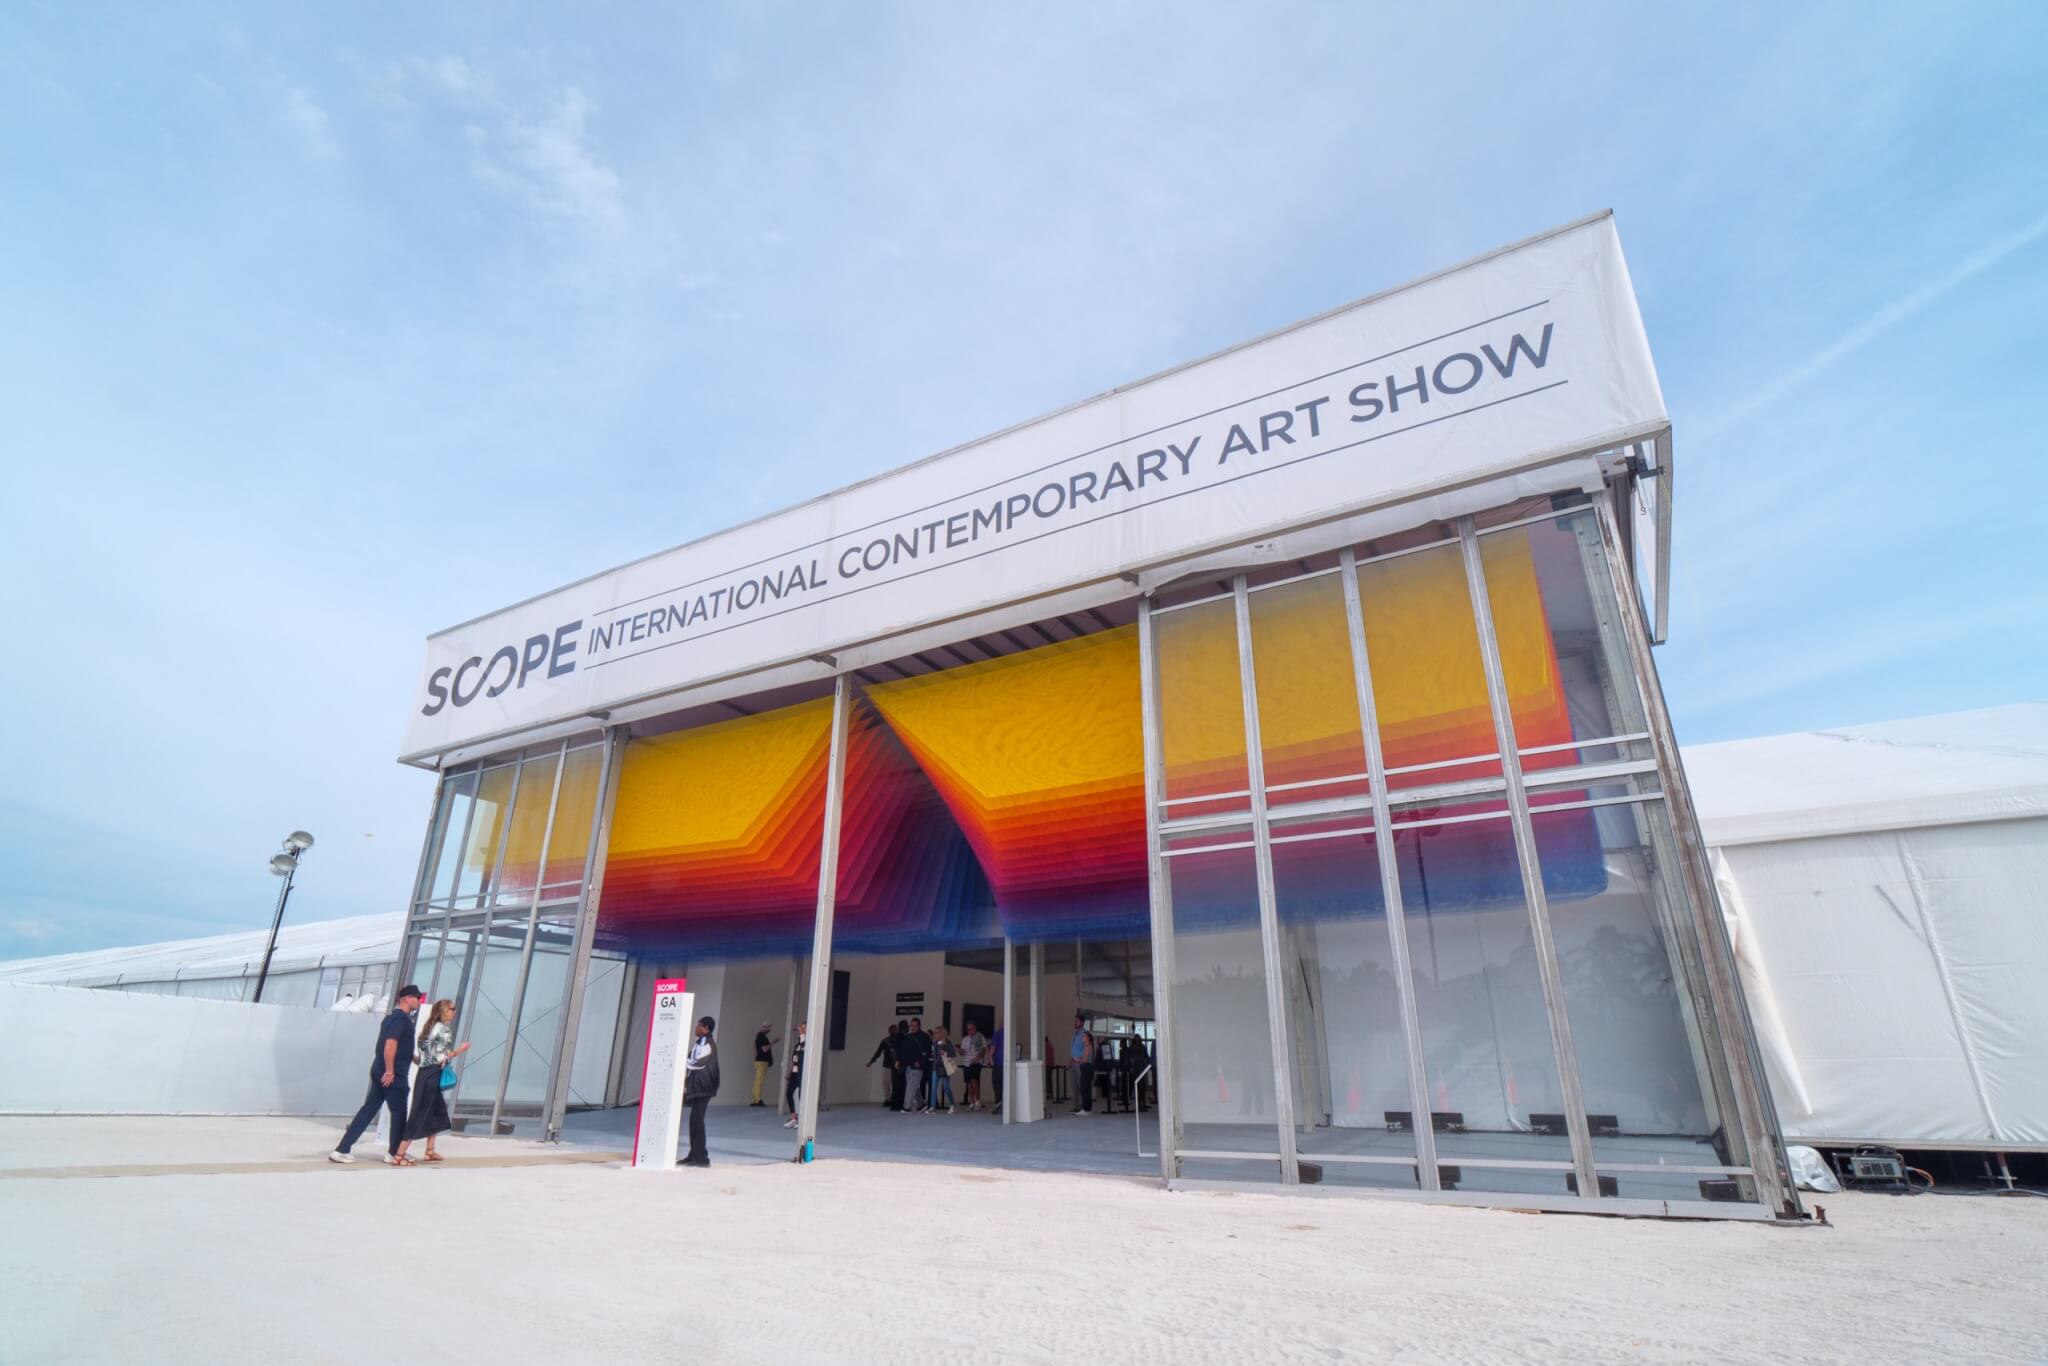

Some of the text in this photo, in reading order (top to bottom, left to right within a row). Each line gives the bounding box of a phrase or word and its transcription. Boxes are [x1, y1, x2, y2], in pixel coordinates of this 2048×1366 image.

[420, 322, 1555, 718] SCOPE INTERNATIONAL CONTEMPORARY ART SHOW
[656, 983, 679, 992] SCOPE
[660, 996, 677, 1008] GA
